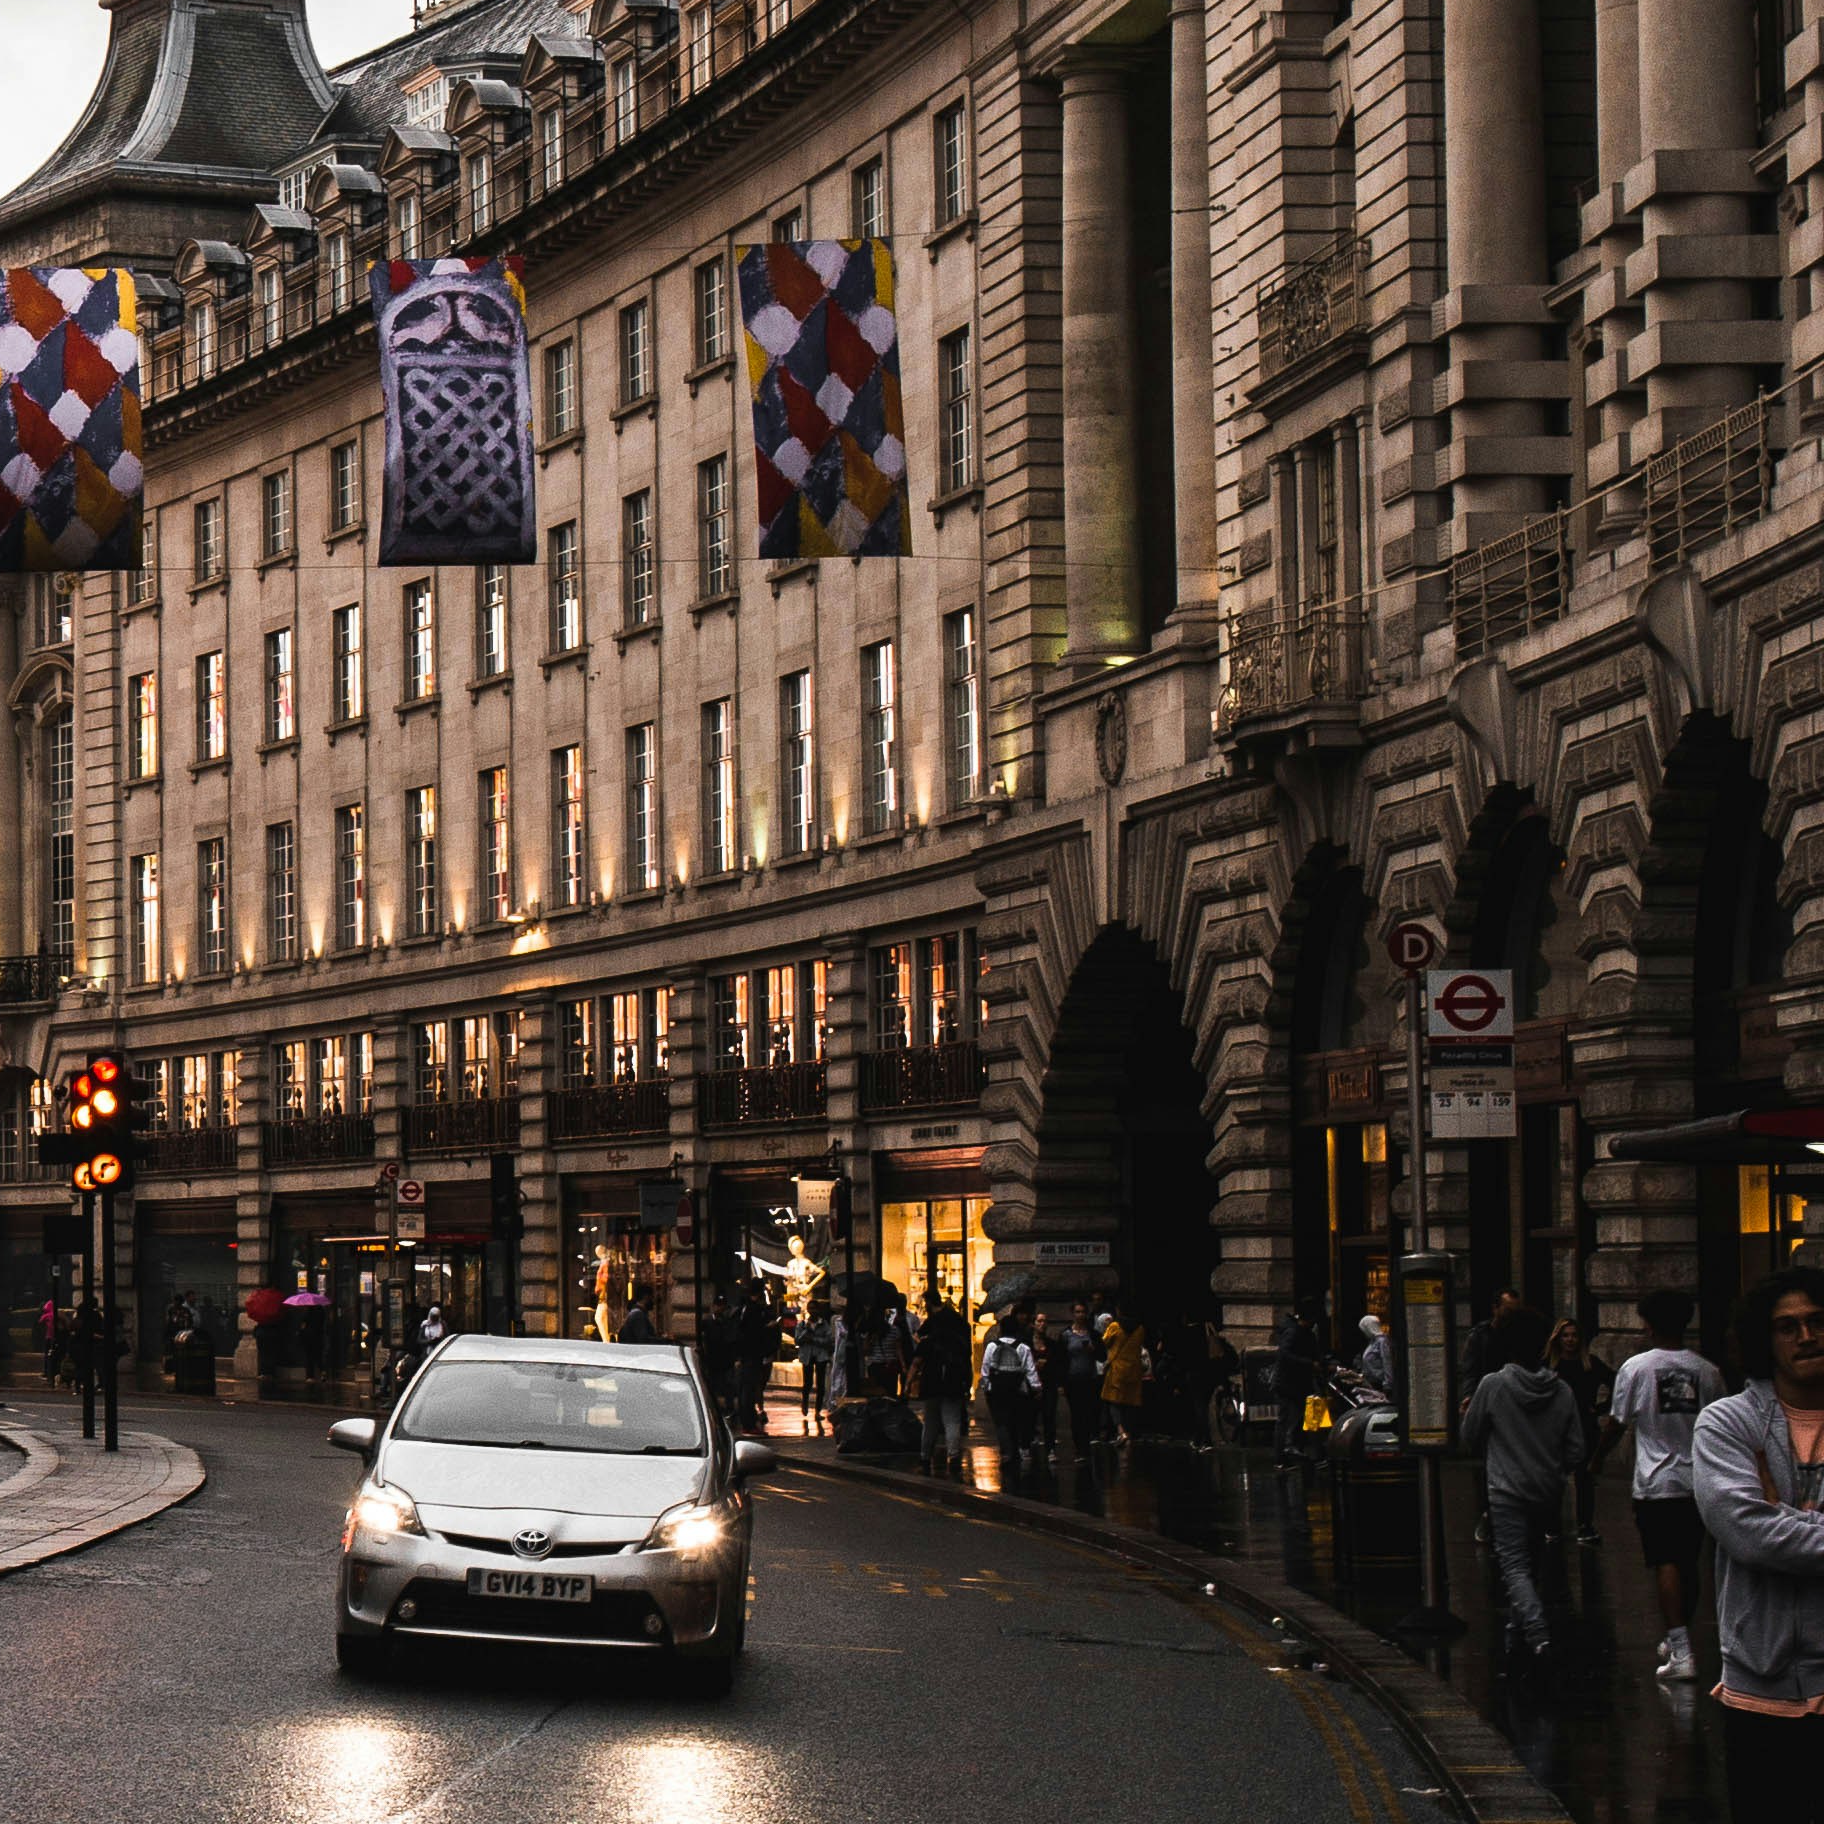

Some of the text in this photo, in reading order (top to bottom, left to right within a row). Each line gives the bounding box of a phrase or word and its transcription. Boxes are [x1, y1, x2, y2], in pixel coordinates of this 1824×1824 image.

[1403, 933, 1428, 962] D
[1467, 1098, 1480, 1107] 94
[386, 1165, 397, 1178] C
[1040, 1244, 1106, 1255] AIR STREET W1
[487, 1572, 585, 1598] GV14 BYP
